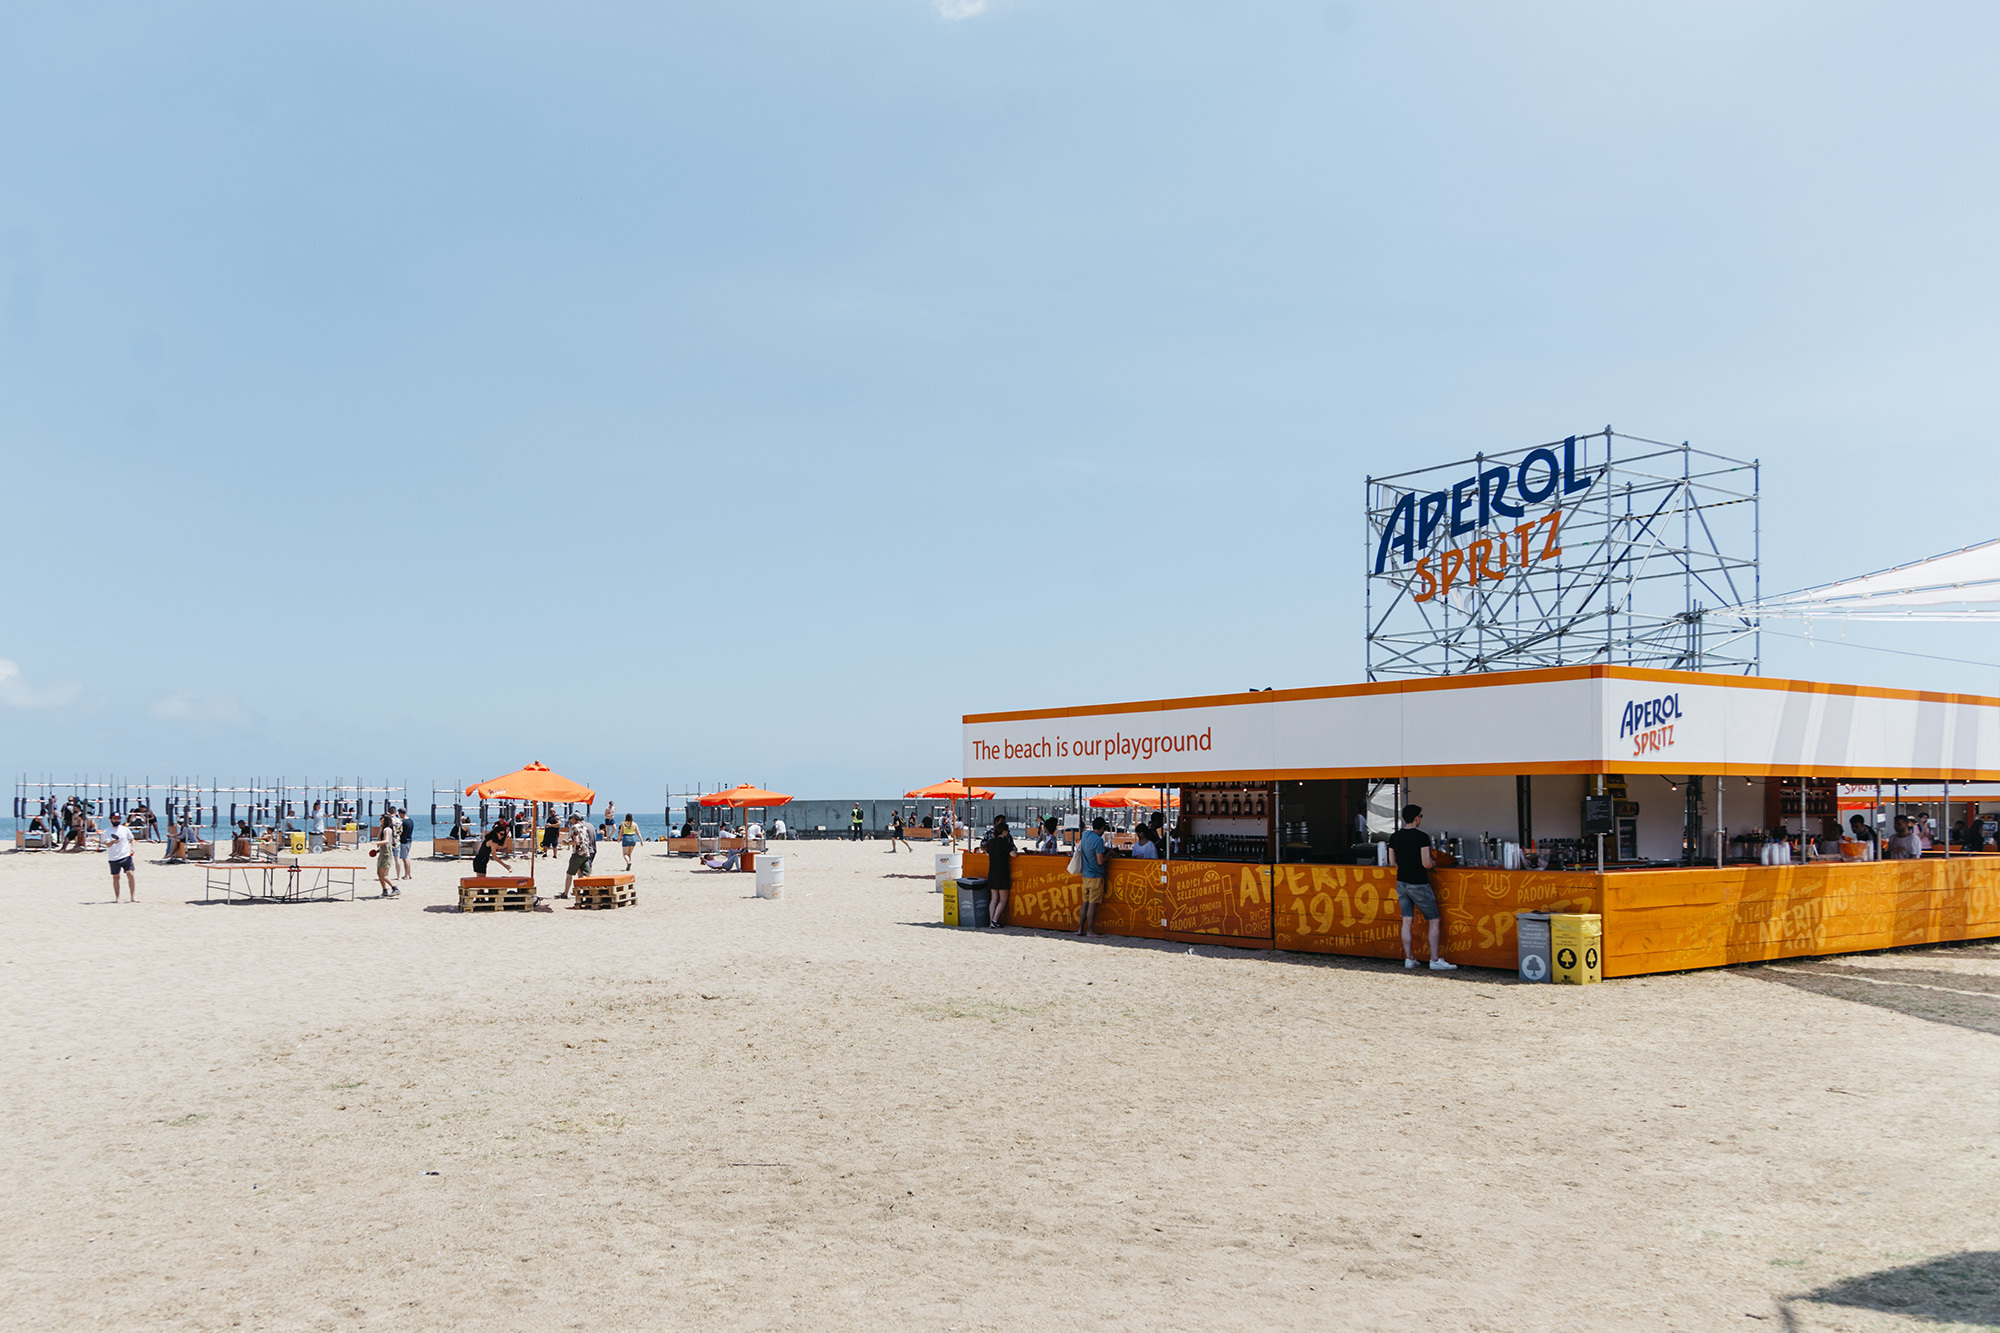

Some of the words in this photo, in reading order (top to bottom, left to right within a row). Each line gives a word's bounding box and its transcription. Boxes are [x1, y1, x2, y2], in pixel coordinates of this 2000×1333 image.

[1375, 435, 1591, 575] APEROL
[1620, 692, 1682, 739] APEROL
[973, 740, 1000, 760] The
[1005, 736, 1051, 759] beach
[1057, 736, 1068, 757] is
[1072, 739, 1102, 757] our
[1105, 727, 1212, 761] playground
[1176, 877, 1201, 891] RADICI
[1517, 883, 1558, 904] PADOVA
[1290, 882, 1380, 935] 1919
